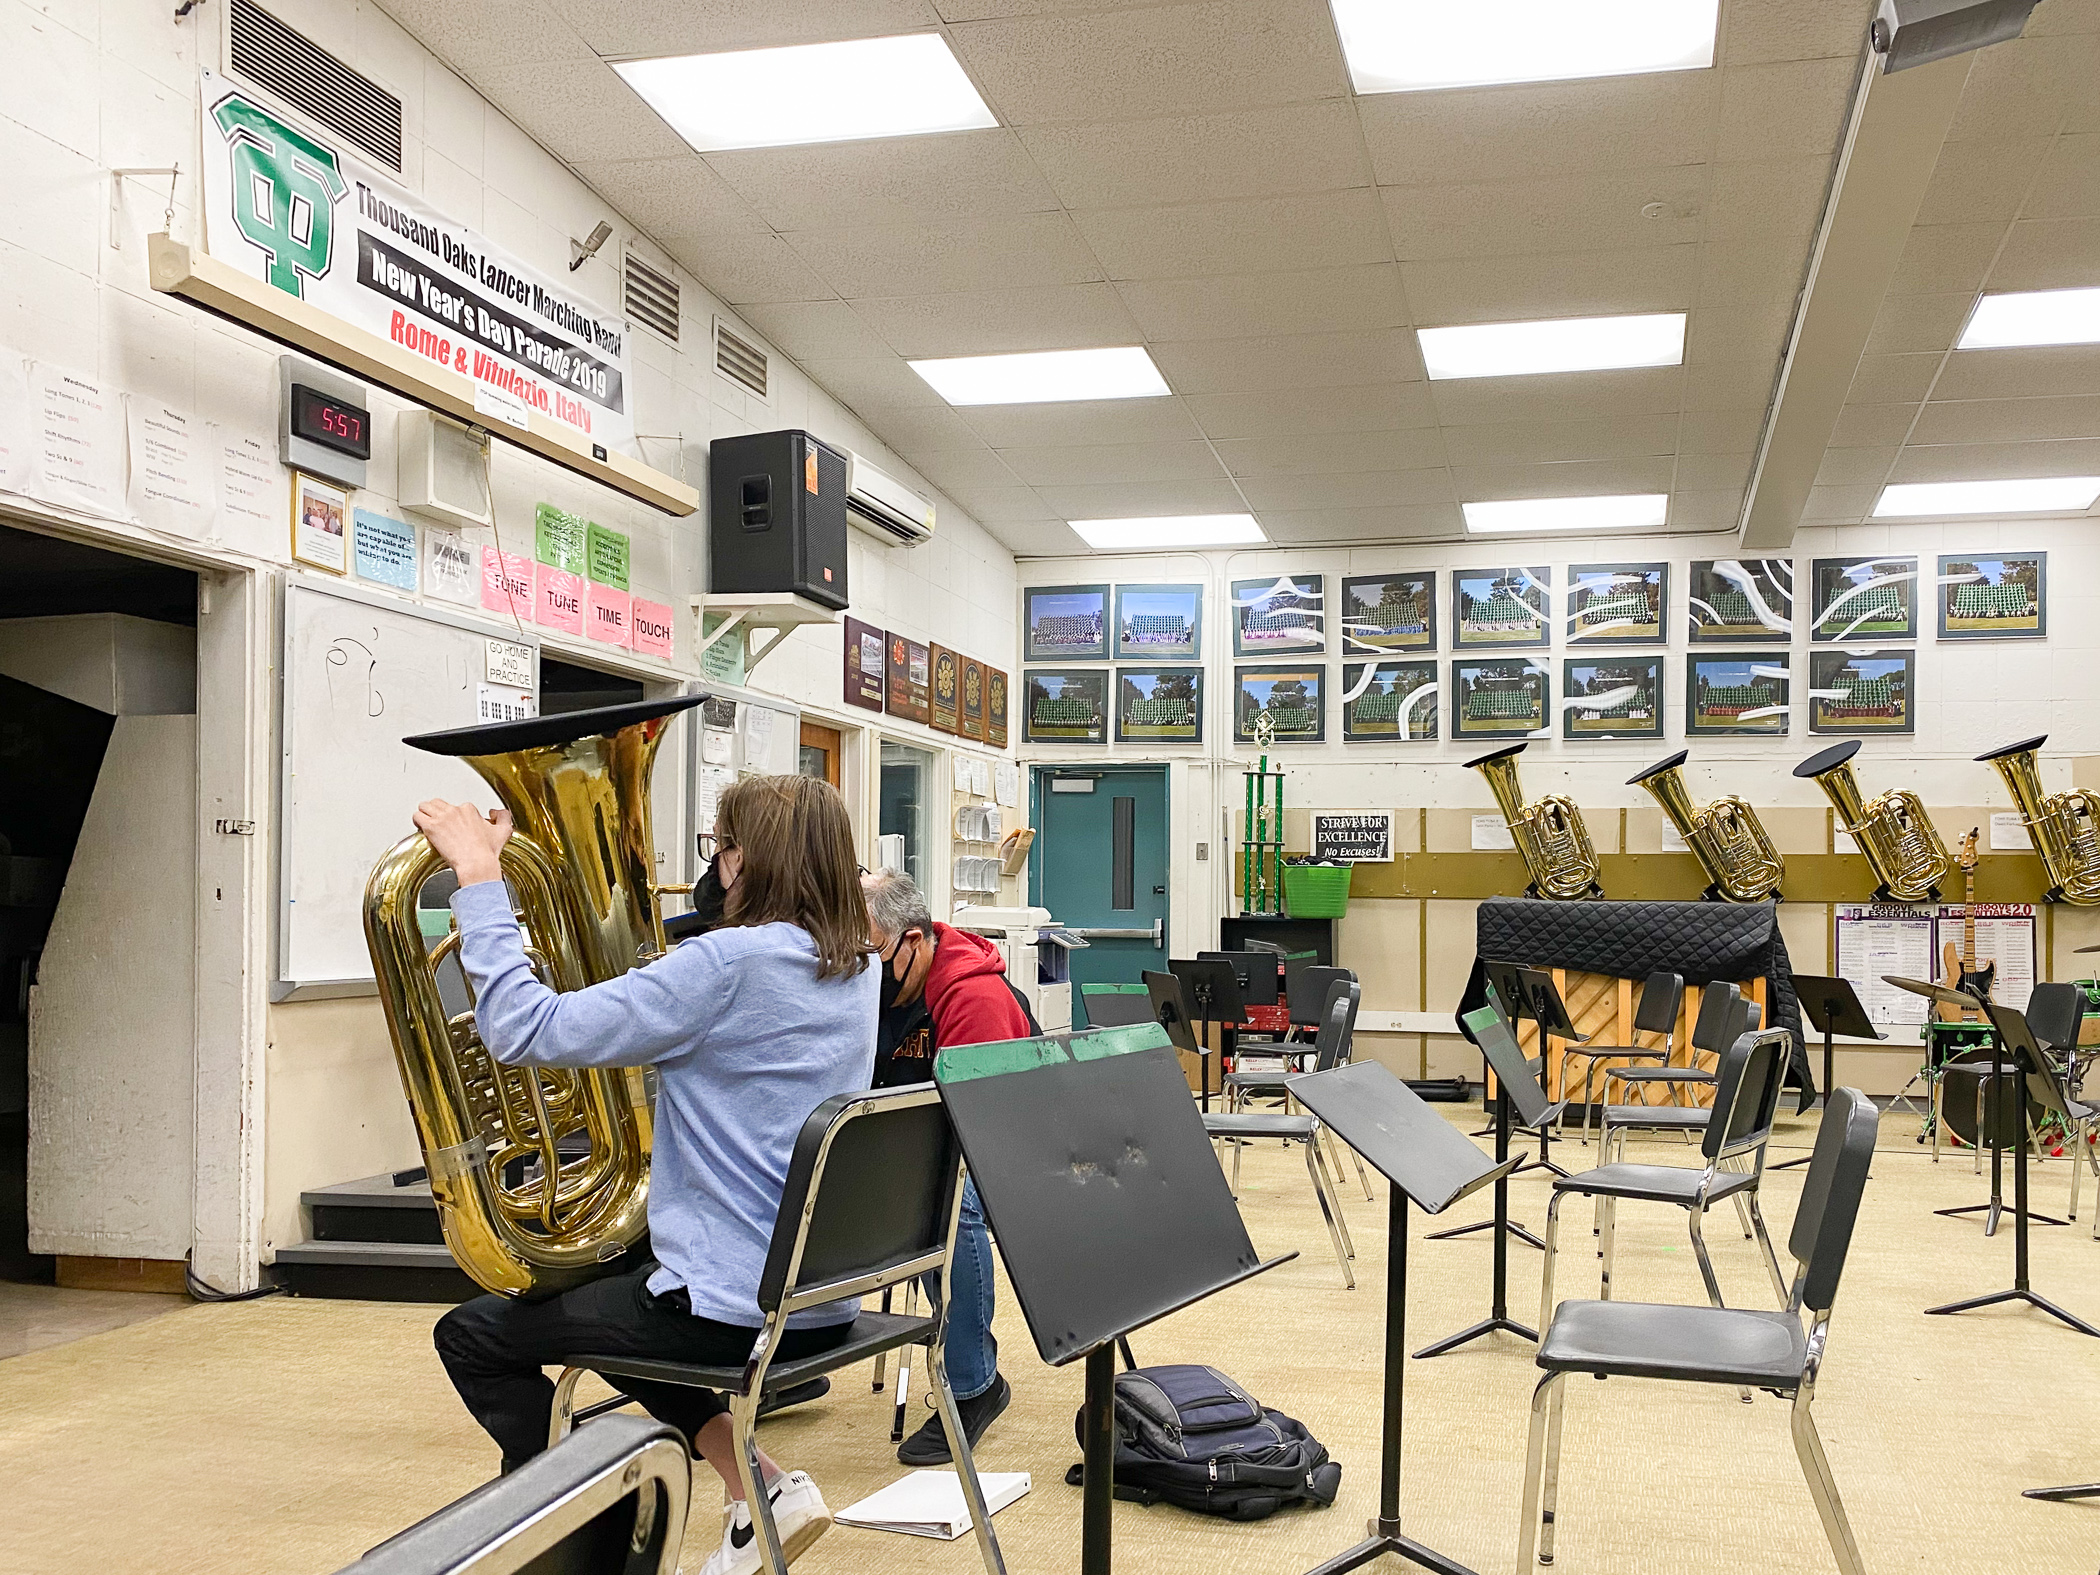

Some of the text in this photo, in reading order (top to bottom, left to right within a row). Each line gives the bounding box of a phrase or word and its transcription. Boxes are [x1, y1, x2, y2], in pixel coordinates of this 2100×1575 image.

[356, 181, 621, 358] Thousand Oaks Lancer Marching Band
[372, 248, 607, 398] New Year's Day Parade 2019
[390, 309, 451, 365] Rome
[453, 346, 468, 374] &
[473, 350, 552, 416] Vitulazio,
[555, 391, 591, 434] Italy
[63, 376, 99, 394] Wednesday
[163, 409, 186, 424] Thursday
[323, 408, 360, 441] 5:57
[244, 439, 260, 450] Friday
[356, 521, 368, 530] It's
[368, 525, 380, 534] not
[381, 529, 398, 540] what
[357, 531, 368, 539] are
[369, 534, 397, 548] capable
[357, 539, 369, 548] but
[370, 544, 387, 554] what
[388, 549, 401, 559] you
[358, 548, 401, 566] willing to do.
[494, 574, 528, 598] TONE
[547, 590, 579, 614] TUNE
[596, 605, 622, 626] TIME
[635, 618, 670, 640] TOUCH
[489, 641, 529, 660] GO HOME
[501, 659, 518, 670] AND
[489, 668, 531, 686] PRACTICE
[1321, 817, 1383, 829] STRIVE FOR
[1318, 831, 1387, 843] EXCELLENCE
[1325, 845, 1380, 857] No Excuses!
[1868, 910, 1931, 918] ESSENTIALS
[1951, 909, 2011, 917] ESNTIALS
[2012, 903, 2032, 916] 2.0
